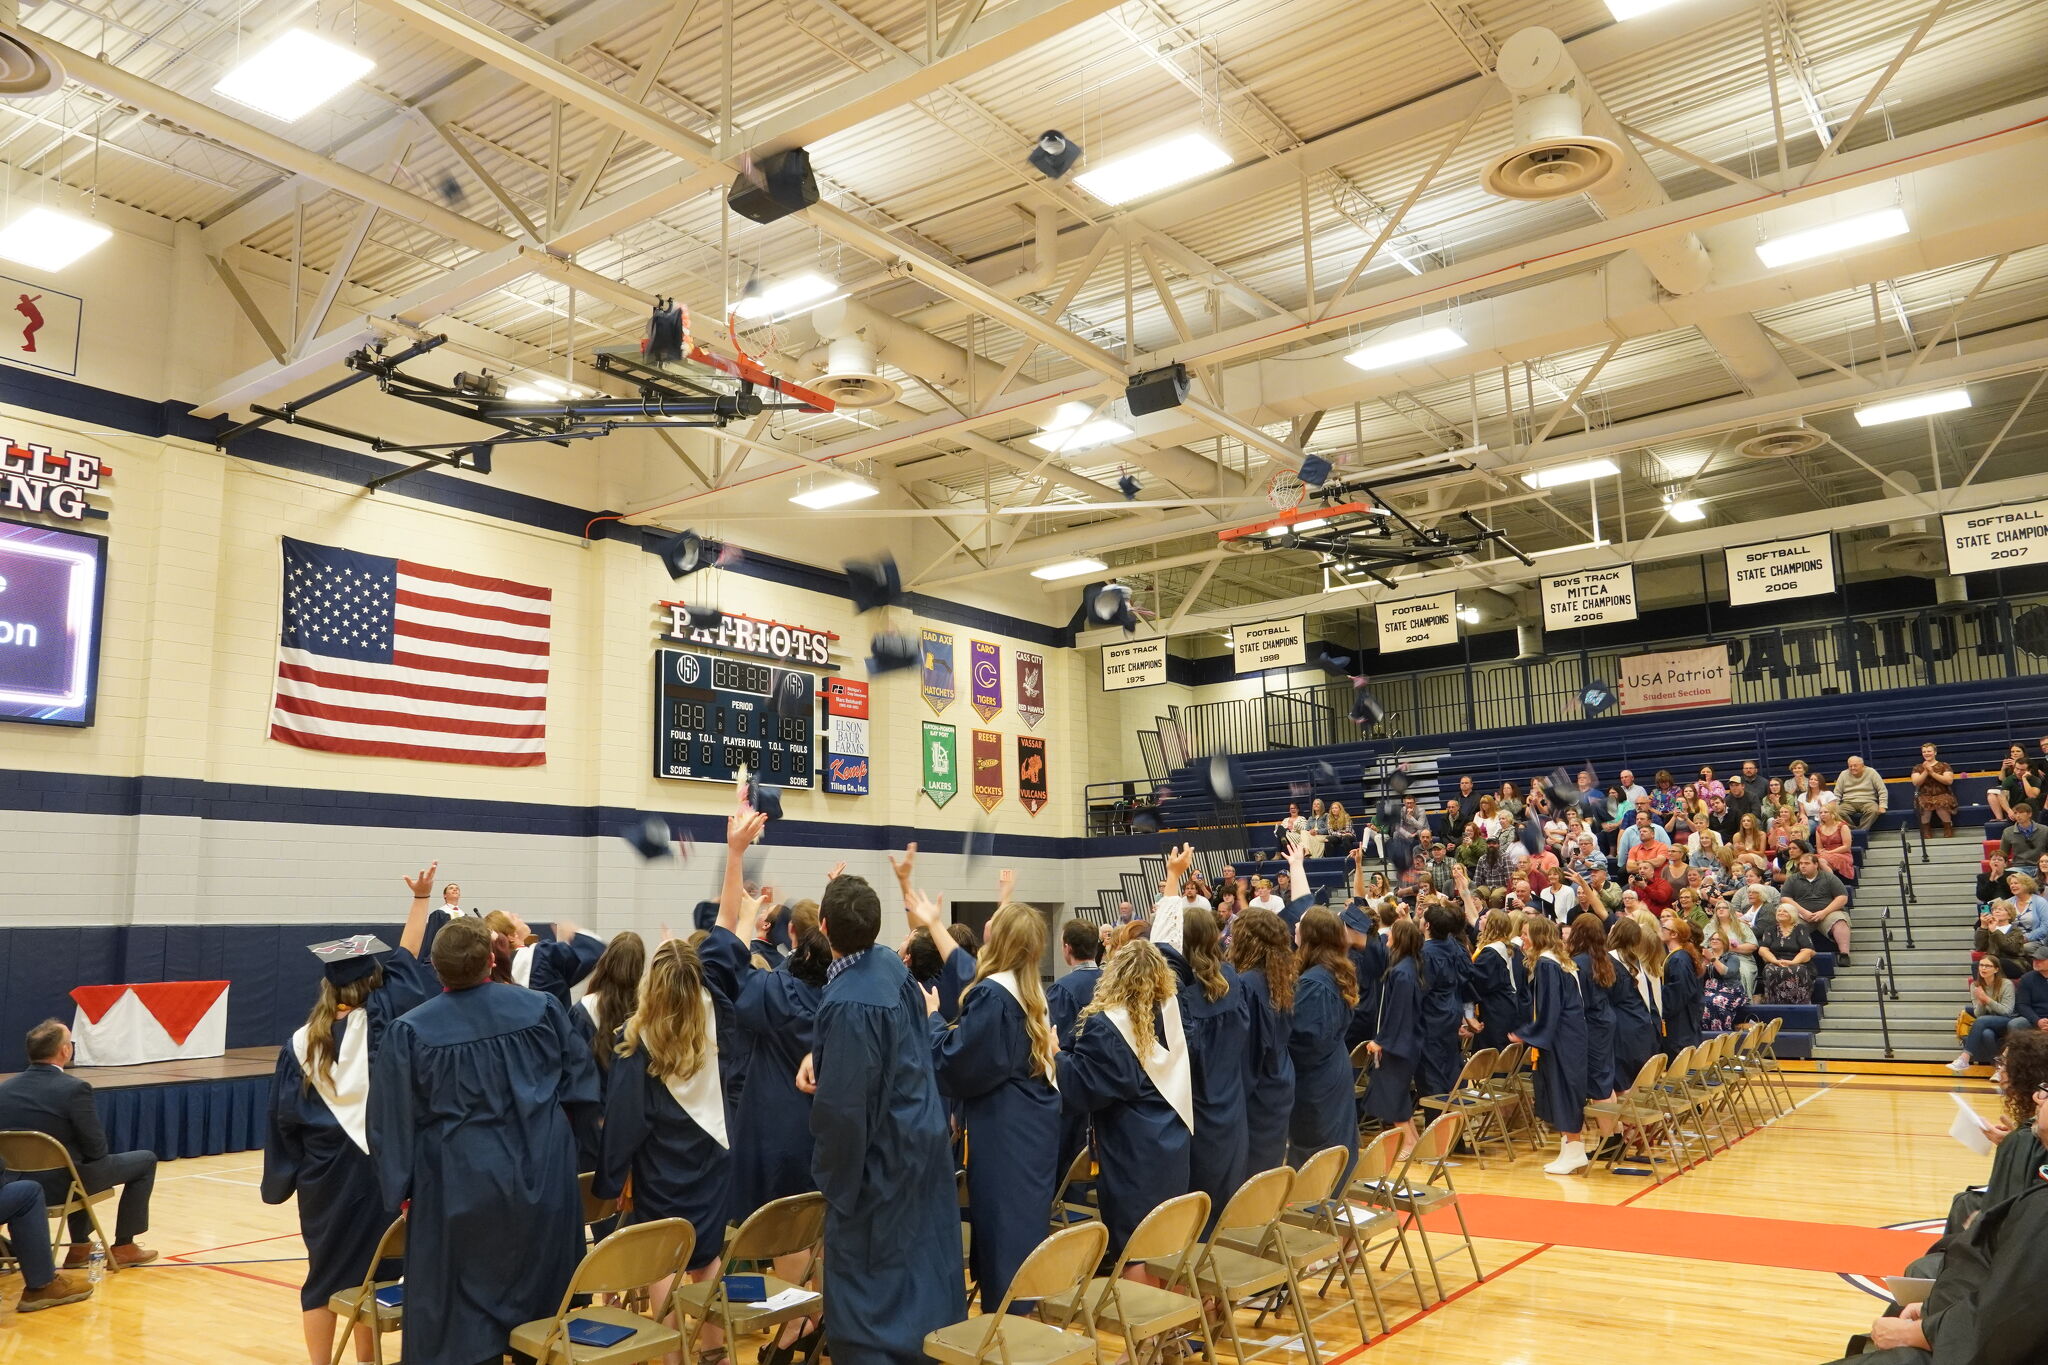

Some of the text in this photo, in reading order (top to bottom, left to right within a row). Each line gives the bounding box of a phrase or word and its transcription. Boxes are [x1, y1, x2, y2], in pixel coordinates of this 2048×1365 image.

[0, 475, 86, 520] NG
[1967, 511, 2043, 528] SOFTBALL
[1956, 534, 1991, 549] STATE
[1746, 546, 1810, 562] SOFTBALL
[1990, 547, 2028, 560] 2007
[1736, 558, 1823, 582] STATE CHAMPIONS
[1553, 571, 1620, 588] BOYS TRACK
[1567, 585, 1608, 599] MITCA
[1765, 581, 1798, 593] 2006
[1392, 602, 1440, 616] FOOTBALL
[1550, 595, 1631, 614] STATE CHAMPIONS
[1385, 614, 1449, 633] STATE CHAMPIONS
[1574, 612, 1603, 622] 2006
[923, 632, 953, 645] BAD AXE
[1246, 626, 1290, 638] FOOTBALL
[1406, 633, 1430, 644] 2004
[976, 643, 995, 655] CARO
[1110, 645, 1158, 658] BOYS TRACK
[1239, 636, 1298, 654] STATE CHAMPIONS
[1016, 651, 1043, 665] CASS CITY
[1107, 659, 1163, 675] STATE CHAMPIONS
[1126, 675, 1145, 684] 1975
[1628, 665, 1723, 688] USA Patriot
[924, 686, 955, 699] HATCHETS
[1643, 687, 1711, 701] Student Section
[731, 700, 754, 711] PERIOD
[976, 694, 997, 706] TIGERS
[1018, 703, 1044, 715] RED HAWKS
[836, 719, 862, 733] ELSON
[670, 730, 692, 741] FOULS
[698, 733, 716, 744] T.O.L.
[837, 731, 860, 743] BAUR
[977, 732, 997, 743] REESE
[723, 736, 762, 749] PLAYER FOUL
[768, 741, 784, 751] T.O.L.
[789, 744, 808, 754] FOULS
[835, 741, 864, 754] FARMS
[1020, 738, 1043, 749] VASSAR
[670, 765, 691, 776] SCORE
[830, 758, 868, 783] Kemp
[789, 776, 808, 786] SCORE
[830, 782, 847, 792] Tiling
[928, 781, 952, 791] LAKERS
[975, 785, 1002, 796] ROCKETS
[1020, 789, 1047, 799] VULCANS
